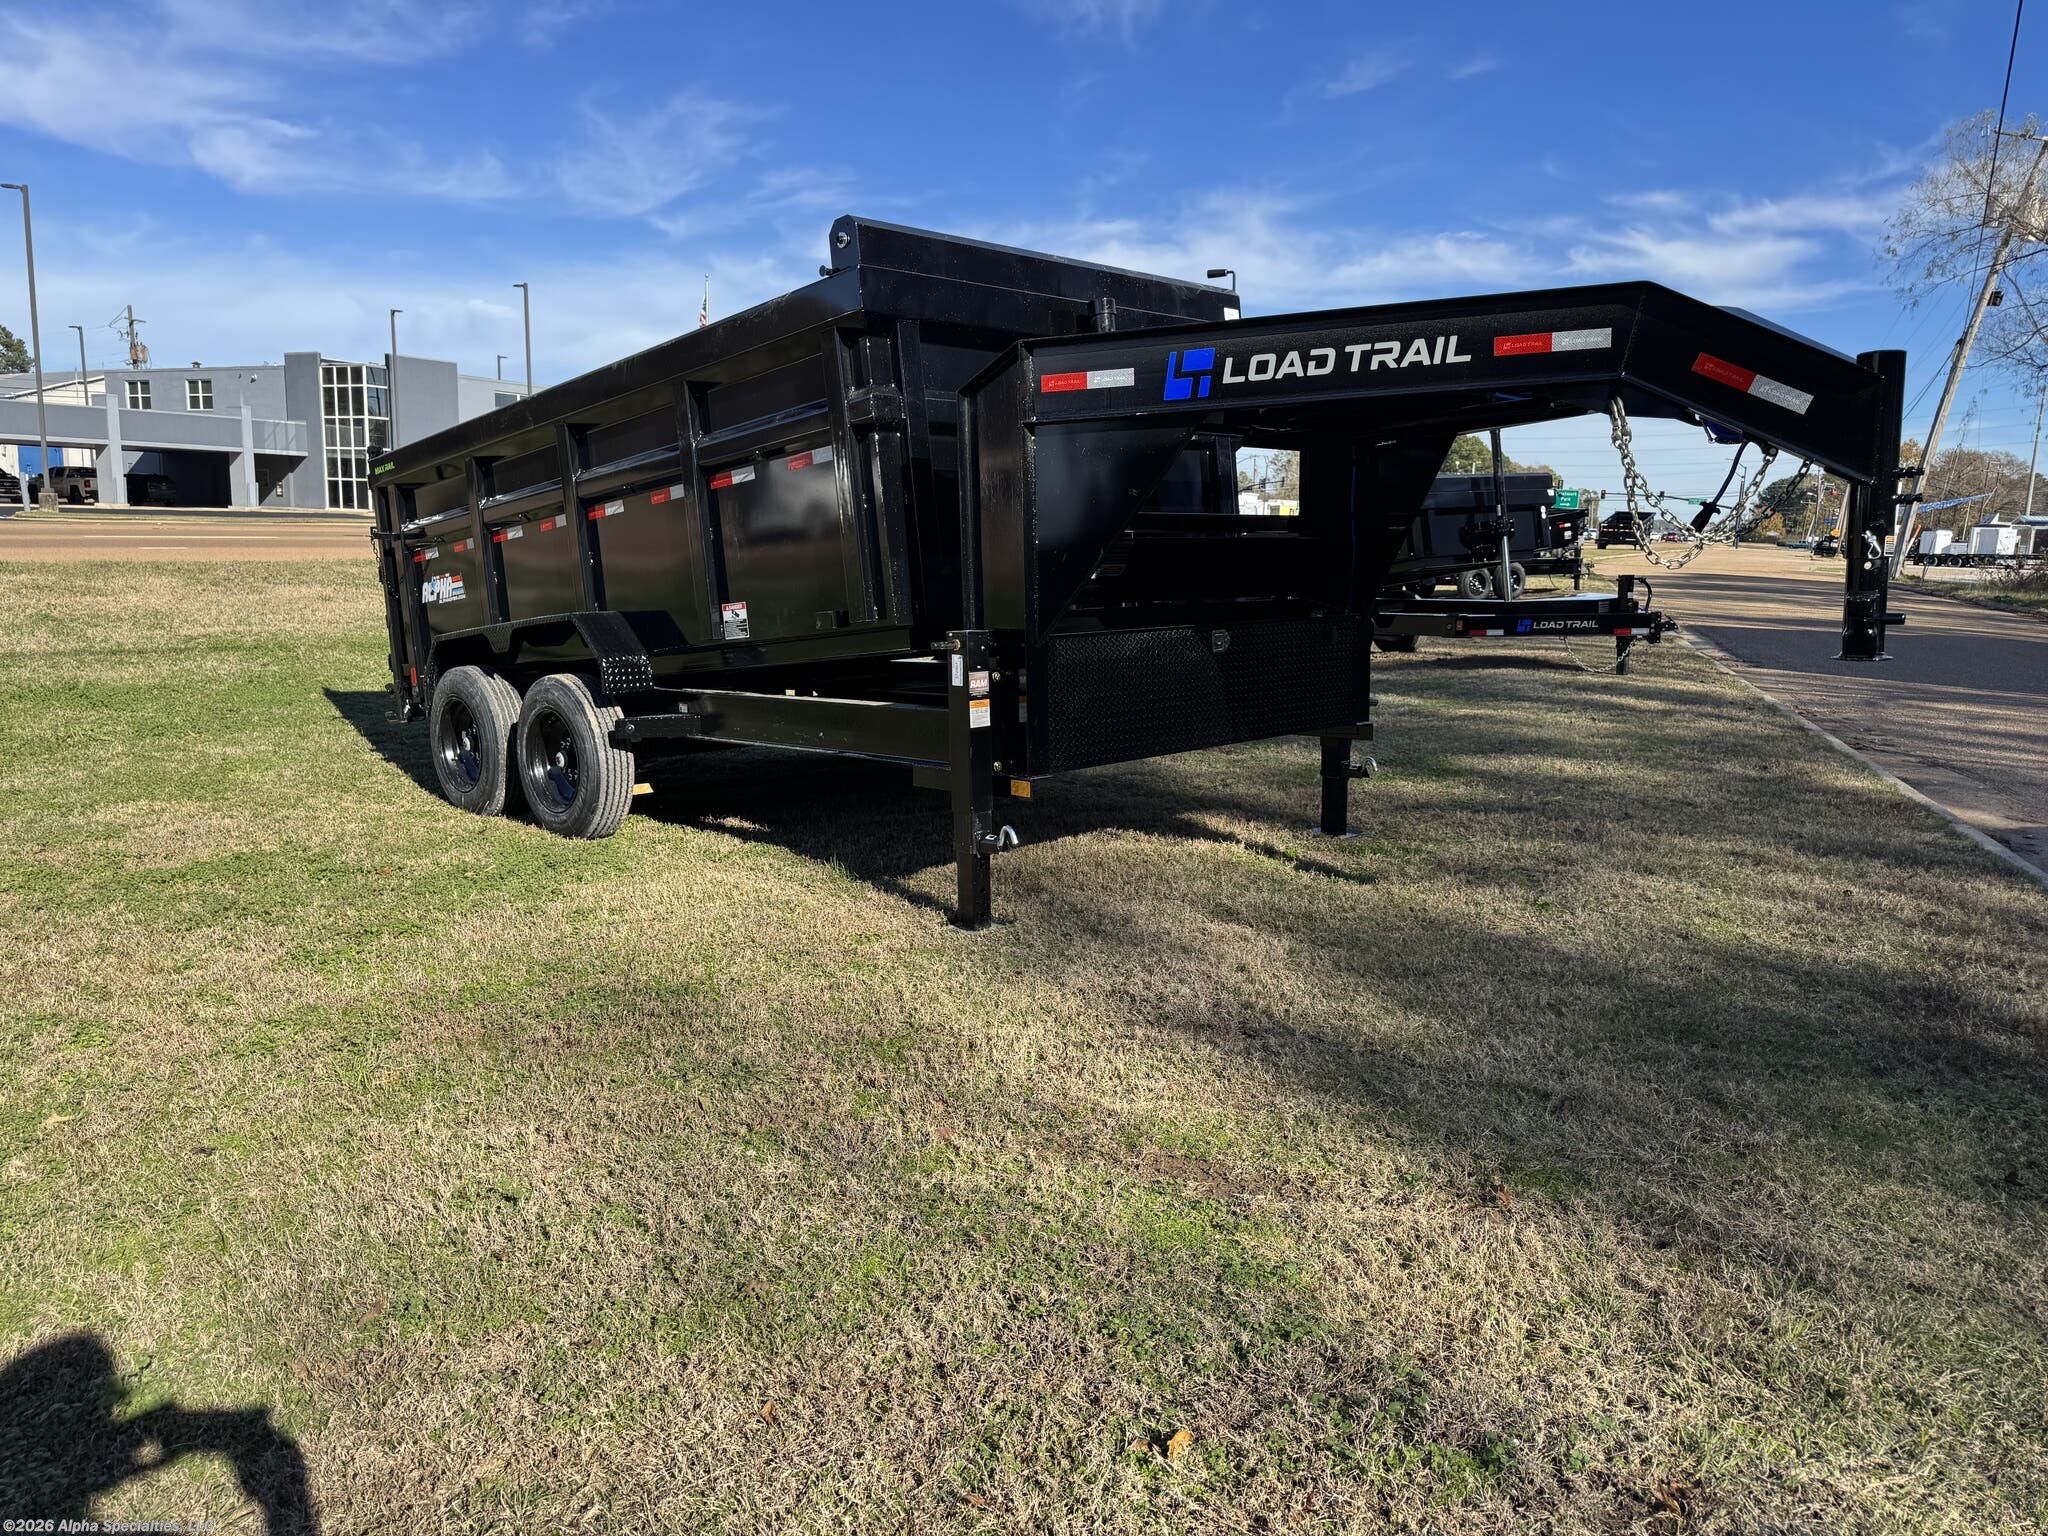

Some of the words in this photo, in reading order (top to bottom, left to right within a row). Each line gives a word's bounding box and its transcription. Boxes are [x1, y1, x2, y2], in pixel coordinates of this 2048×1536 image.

[1222, 347, 1336, 384] LOAD
[1344, 335, 1472, 372] TRAIL
[422, 576, 453, 603] ALPHA
[1533, 621, 1565, 629] LOAD
[1566, 620, 1599, 628] TRAIL
[970, 679, 988, 689] RAM
